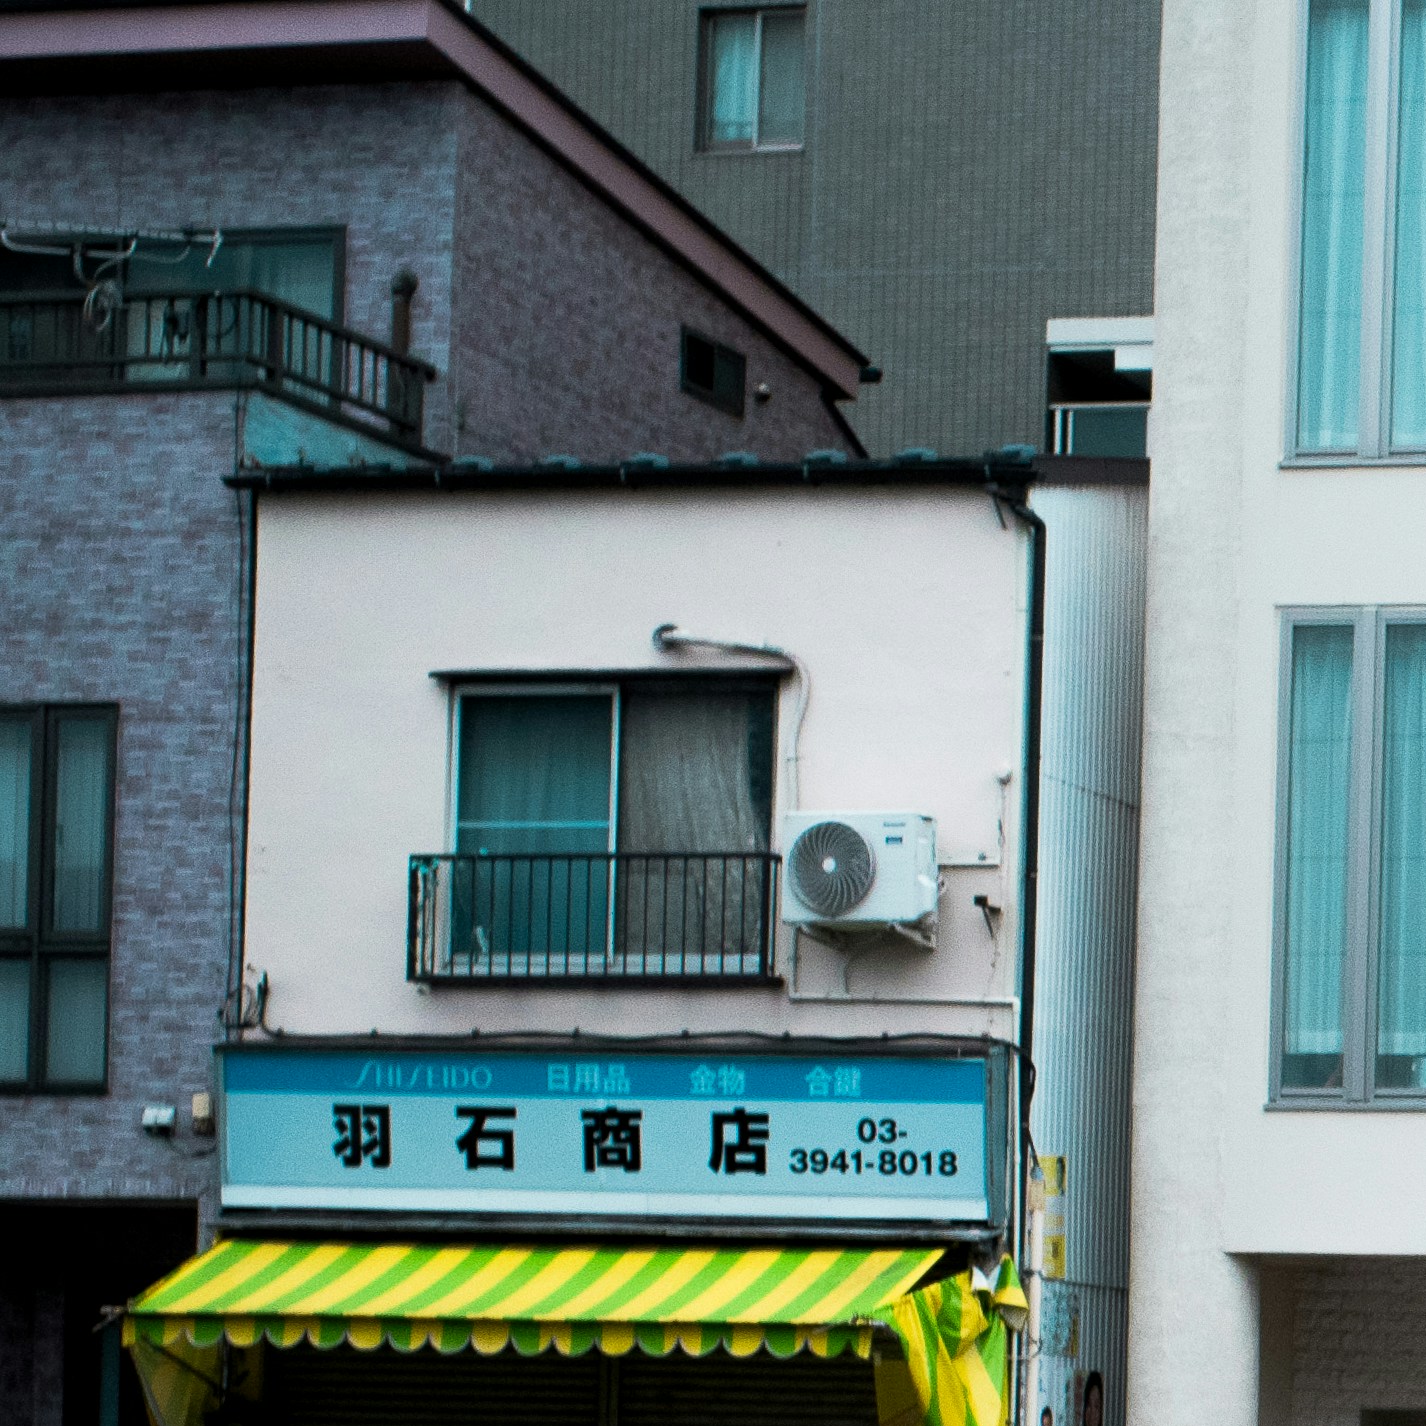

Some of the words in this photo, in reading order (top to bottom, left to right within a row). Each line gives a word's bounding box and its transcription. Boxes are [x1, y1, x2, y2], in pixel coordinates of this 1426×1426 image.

[350, 1059, 494, 1091] SHISEIDO
[547, 1063, 631, 1095] 日用品
[689, 1064, 745, 1096] 金物
[331, 1102, 771, 1176] 羽石商店
[857, 1117, 908, 1144] 03-
[788, 1147, 958, 1177] 3941-8018
